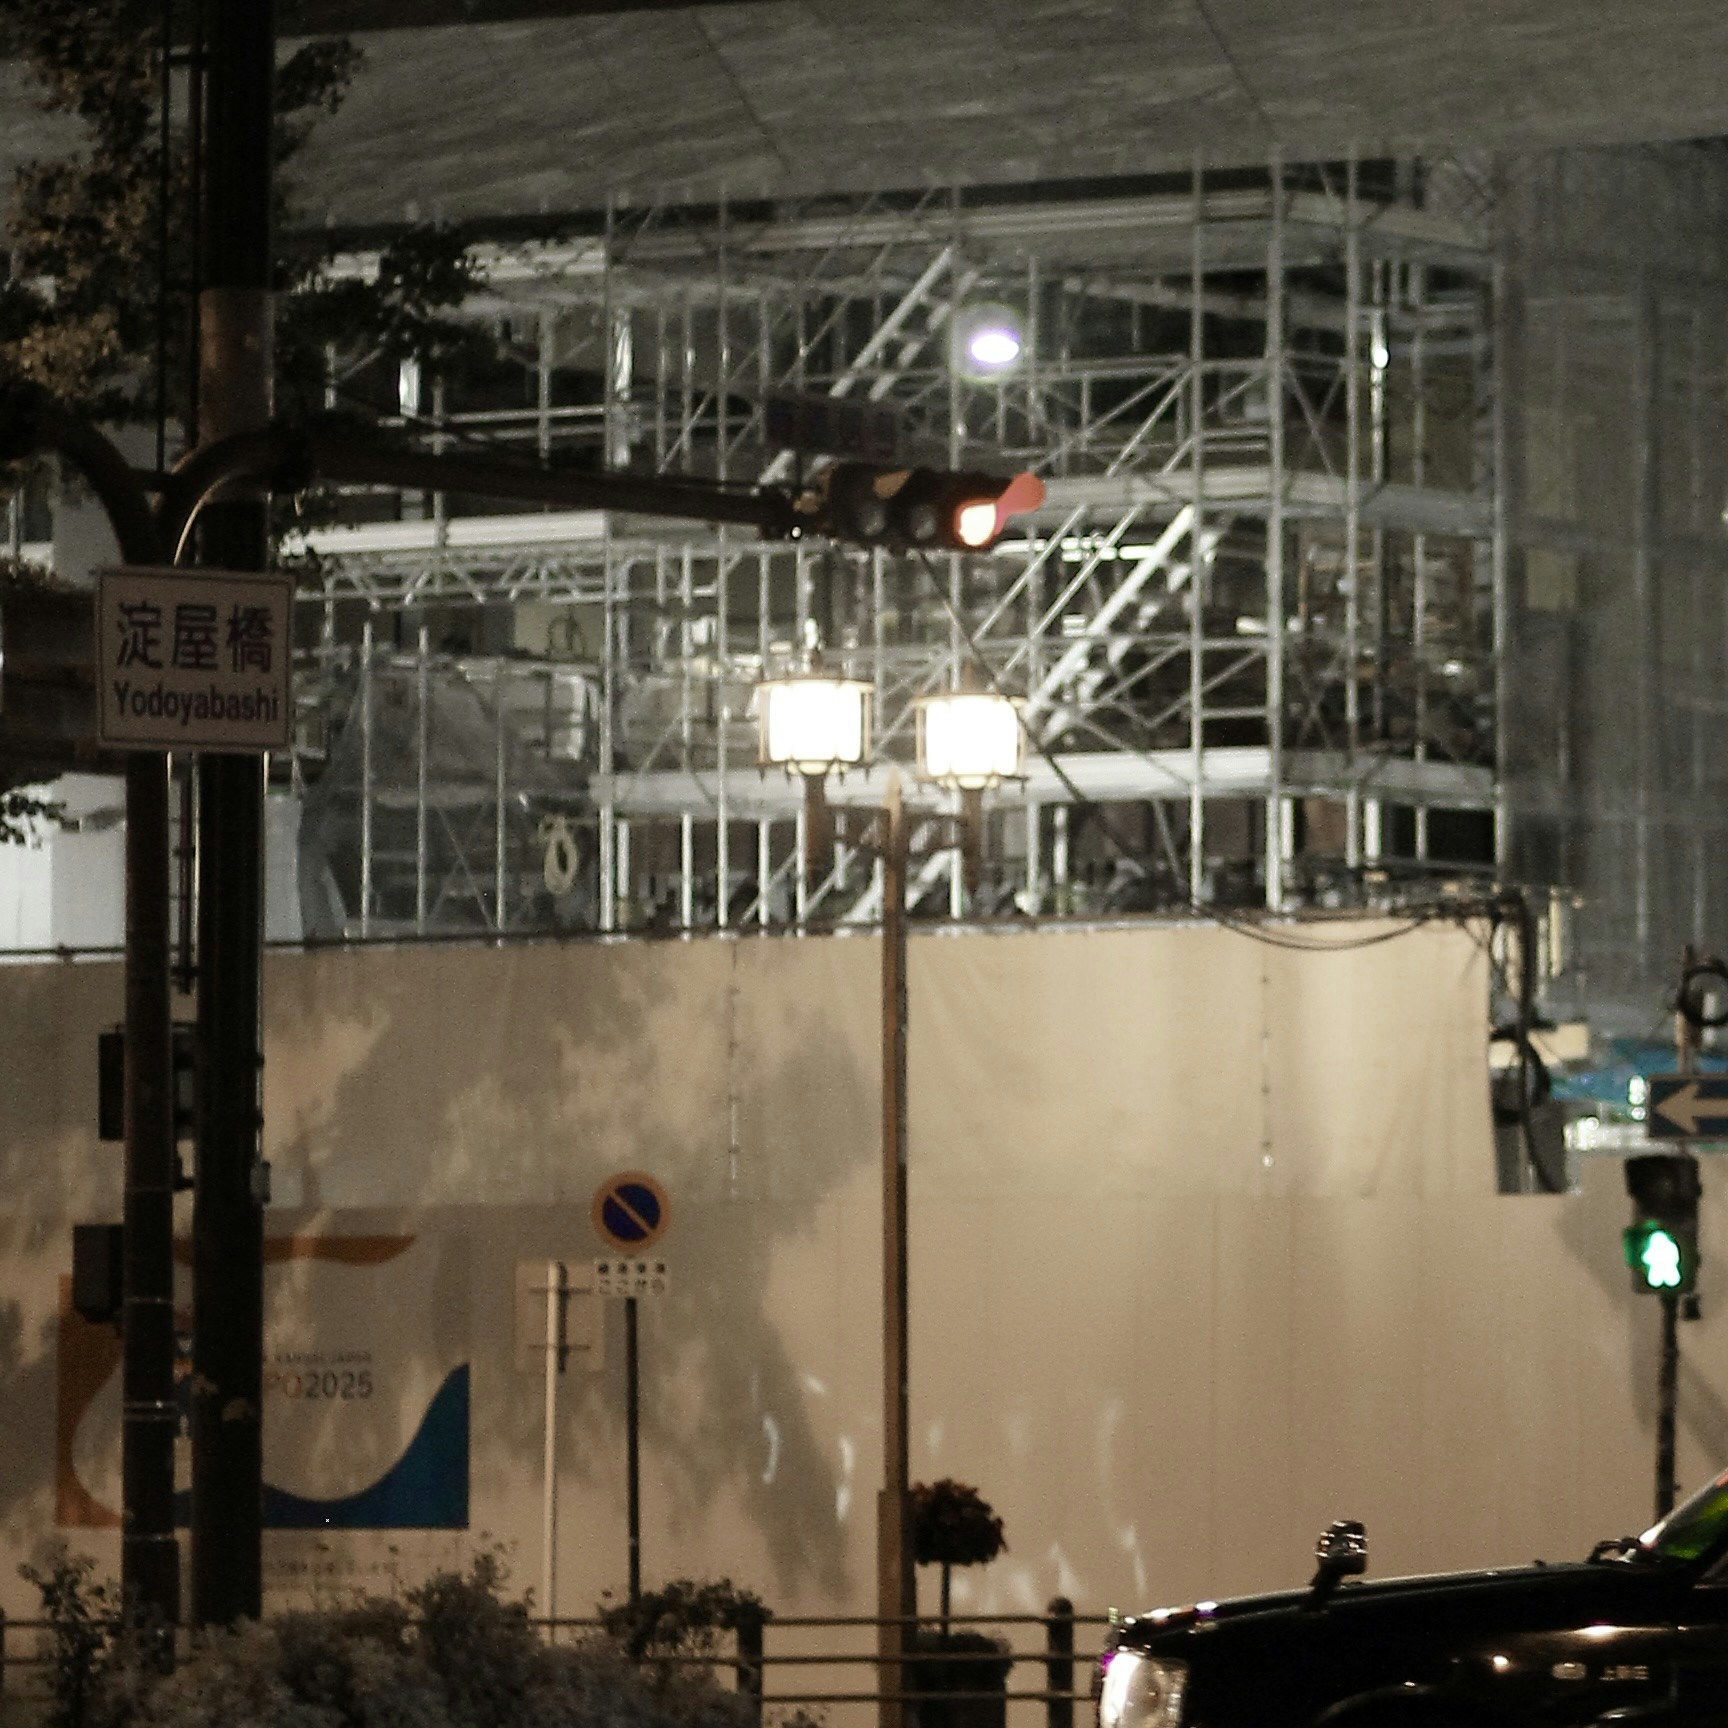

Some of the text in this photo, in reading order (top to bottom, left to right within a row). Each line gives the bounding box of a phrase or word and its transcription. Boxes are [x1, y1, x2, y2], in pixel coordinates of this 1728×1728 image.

[117, 602, 273, 672] 淀屋橋
[114, 681, 278, 725] Yodoyabashi
